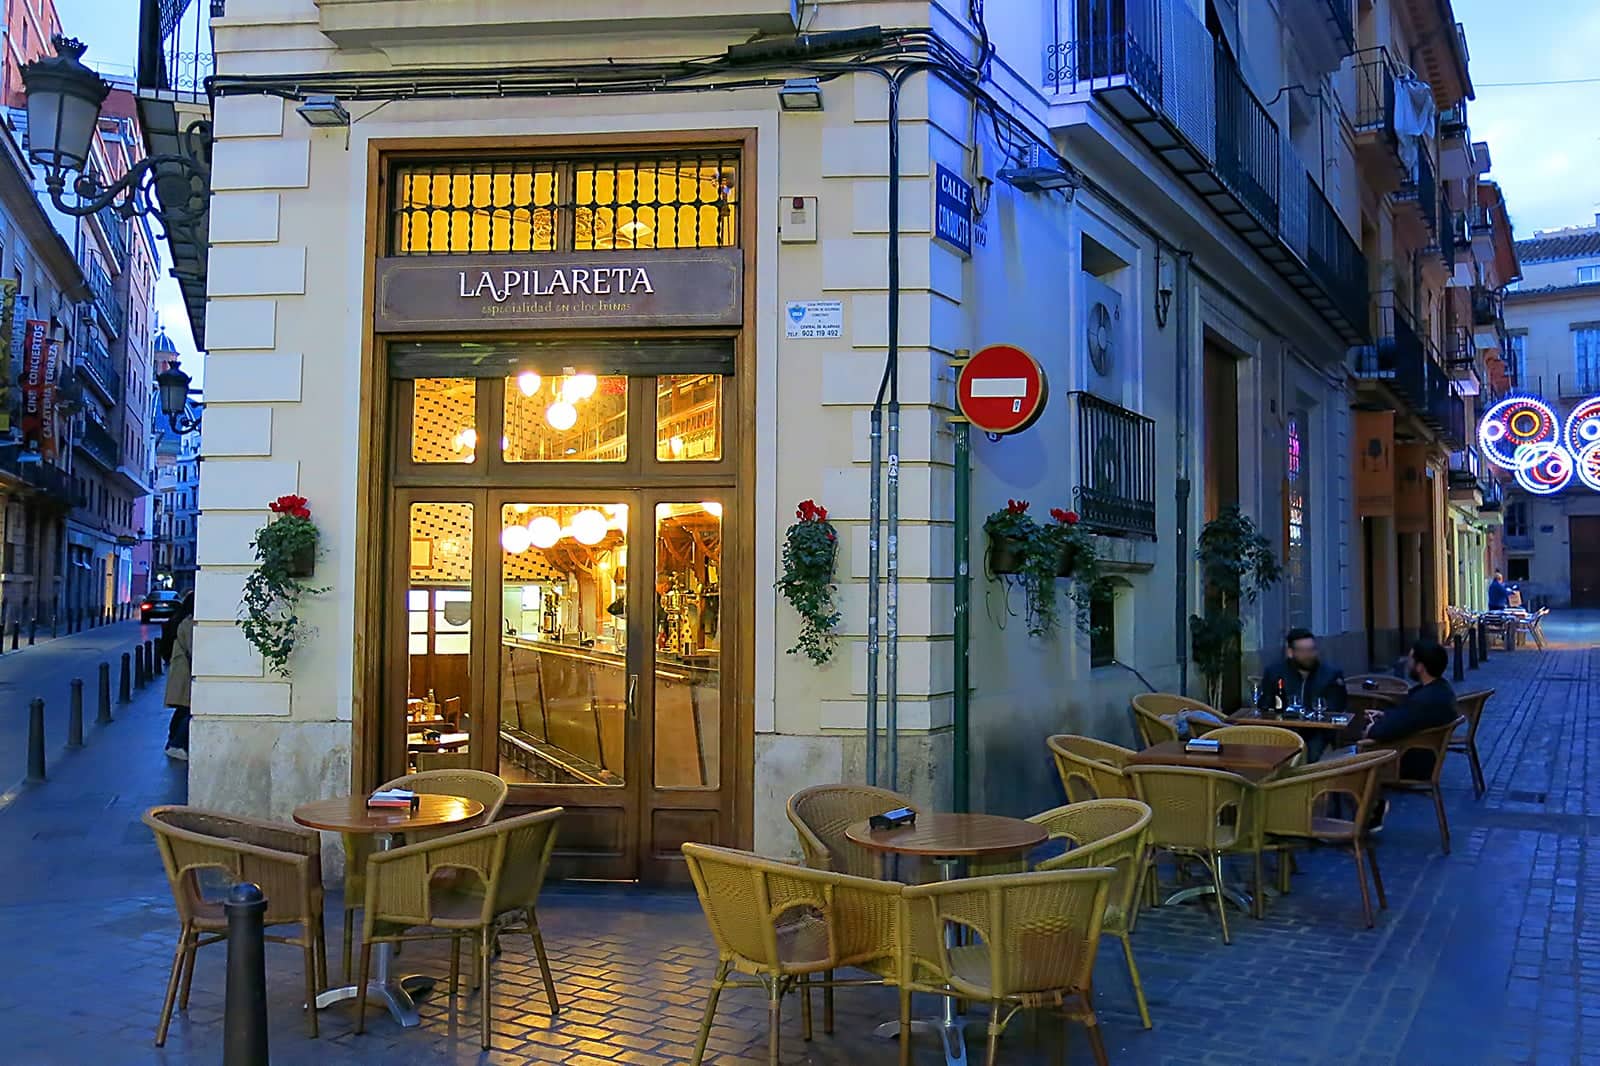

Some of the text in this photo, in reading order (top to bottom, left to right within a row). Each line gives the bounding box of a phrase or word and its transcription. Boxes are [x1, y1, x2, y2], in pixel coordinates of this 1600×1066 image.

[941, 174, 968, 206] CALLE
[28, 324, 45, 386] CONCIERTOS
[45, 344, 58, 385] TERRAZA
